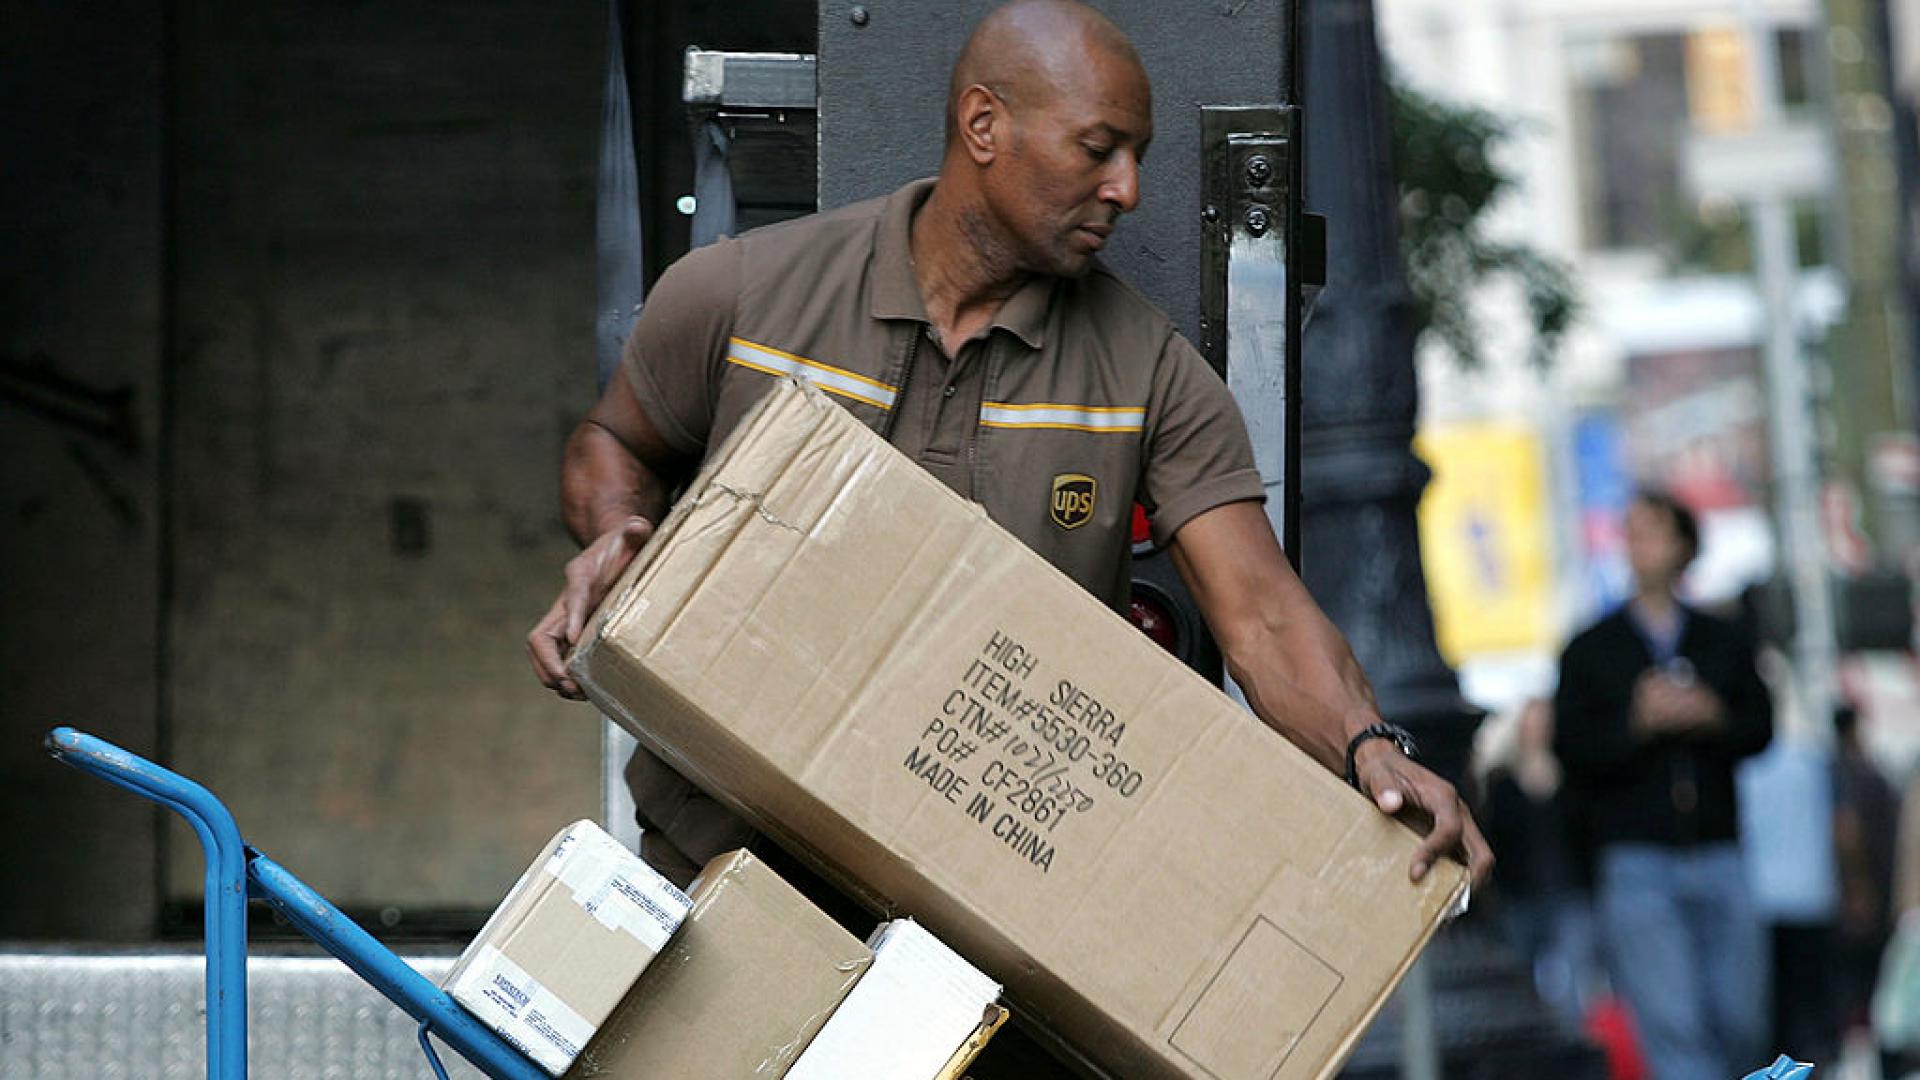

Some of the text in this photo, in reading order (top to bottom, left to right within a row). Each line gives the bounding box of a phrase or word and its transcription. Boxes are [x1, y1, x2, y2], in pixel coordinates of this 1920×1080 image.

[1055, 490, 1091, 520] ups
[962, 658, 1143, 798] ITEM#5530-360
[983, 630, 1126, 748] HIGH SIERRA
[903, 746, 1056, 873] MADE IN CHINA
[921, 717, 1067, 832] PO# CF2861
